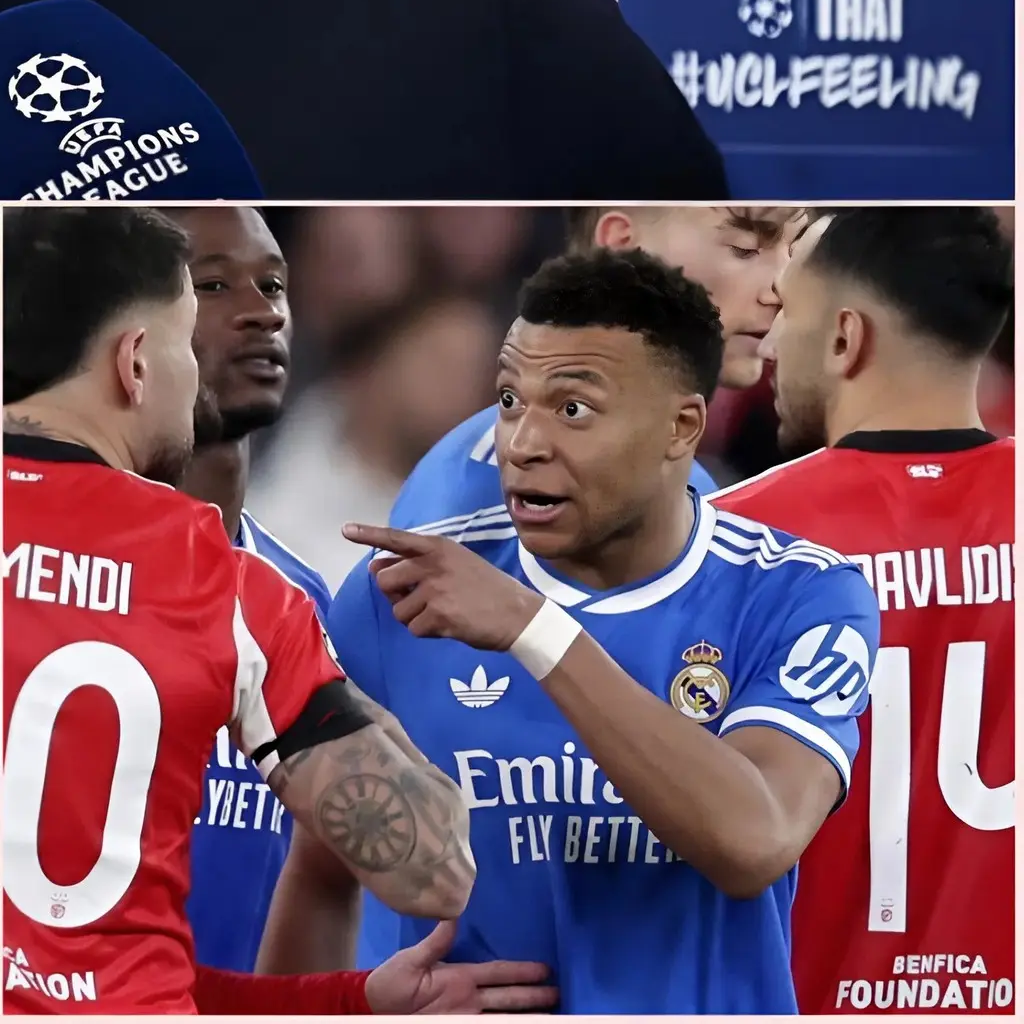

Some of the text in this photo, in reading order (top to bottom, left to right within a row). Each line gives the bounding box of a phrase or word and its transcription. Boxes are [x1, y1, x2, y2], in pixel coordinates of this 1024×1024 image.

[671, 50, 981, 119] #UCLFEELING
[64, 122, 122, 154] UEFA
[508, 815, 553, 865] FLY
[892, 954, 987, 975] BENFICA
[835, 977, 1013, 1009] FOUNDATIO
